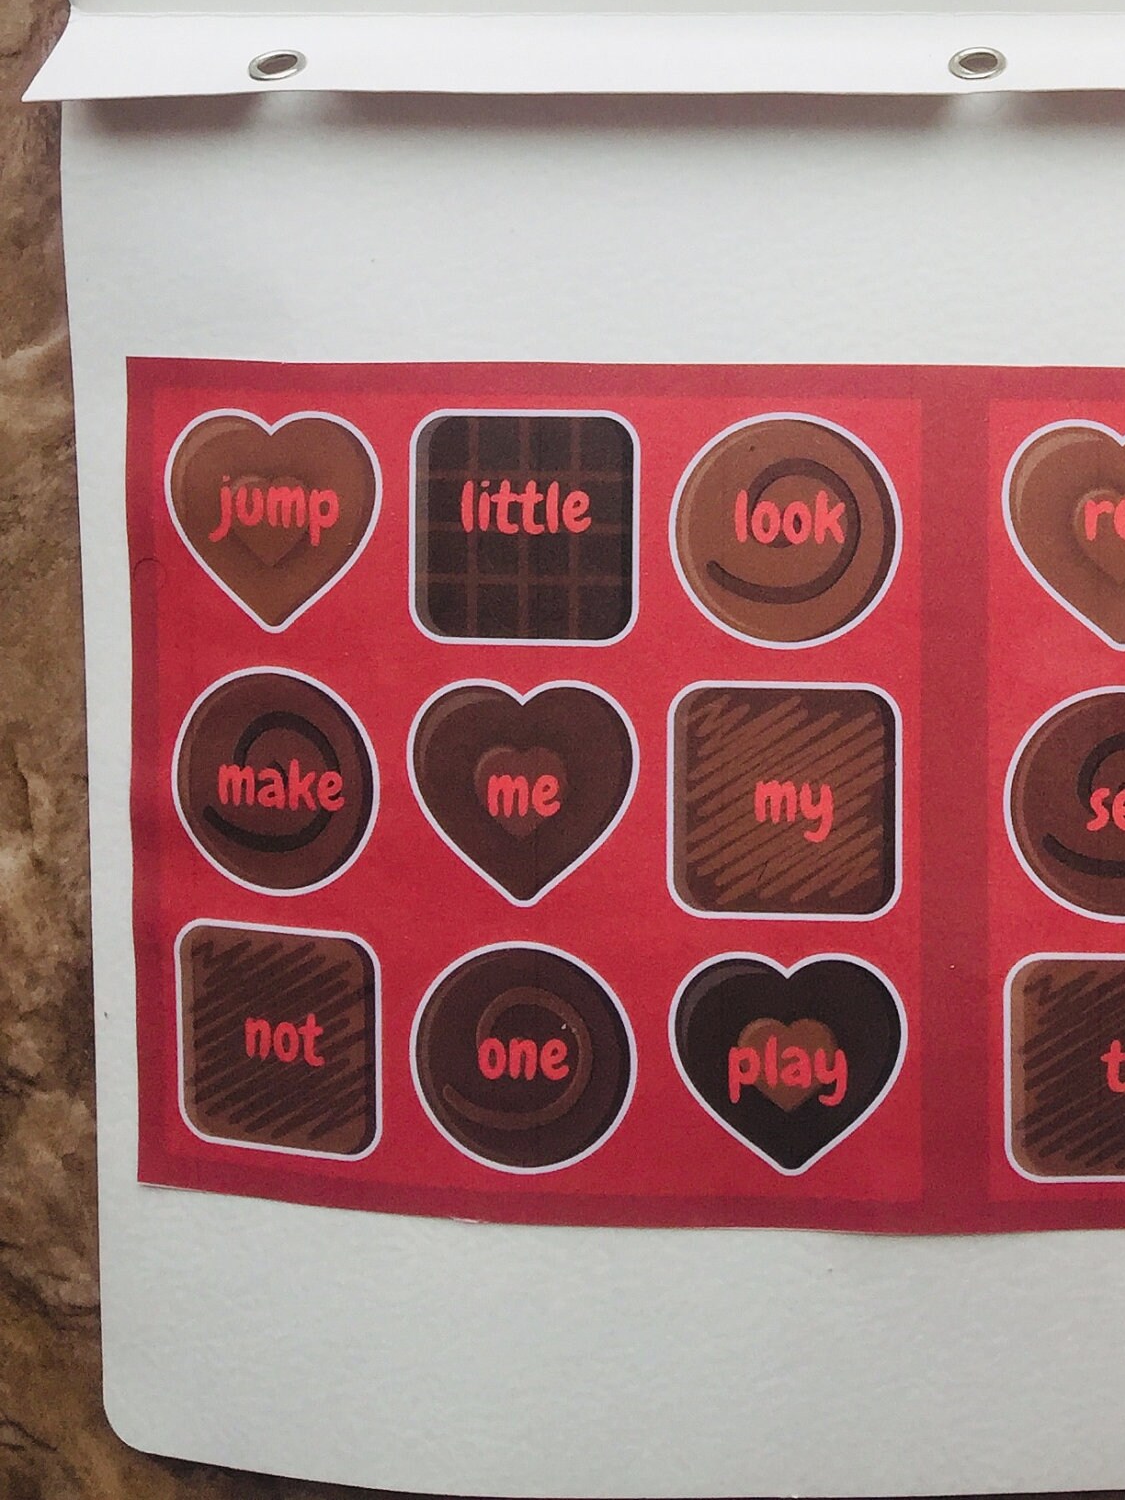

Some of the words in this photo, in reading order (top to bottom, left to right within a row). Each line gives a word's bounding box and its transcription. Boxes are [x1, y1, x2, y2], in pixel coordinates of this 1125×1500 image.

[209, 475, 339, 545] jump
[461, 479, 591, 534] little
[734, 490, 844, 544] look
[218, 759, 345, 810] make
[487, 774, 560, 816] me
[755, 781, 833, 842] my
[245, 1014, 325, 1066] not
[478, 1038, 569, 1080] one
[729, 1034, 848, 1106] play
